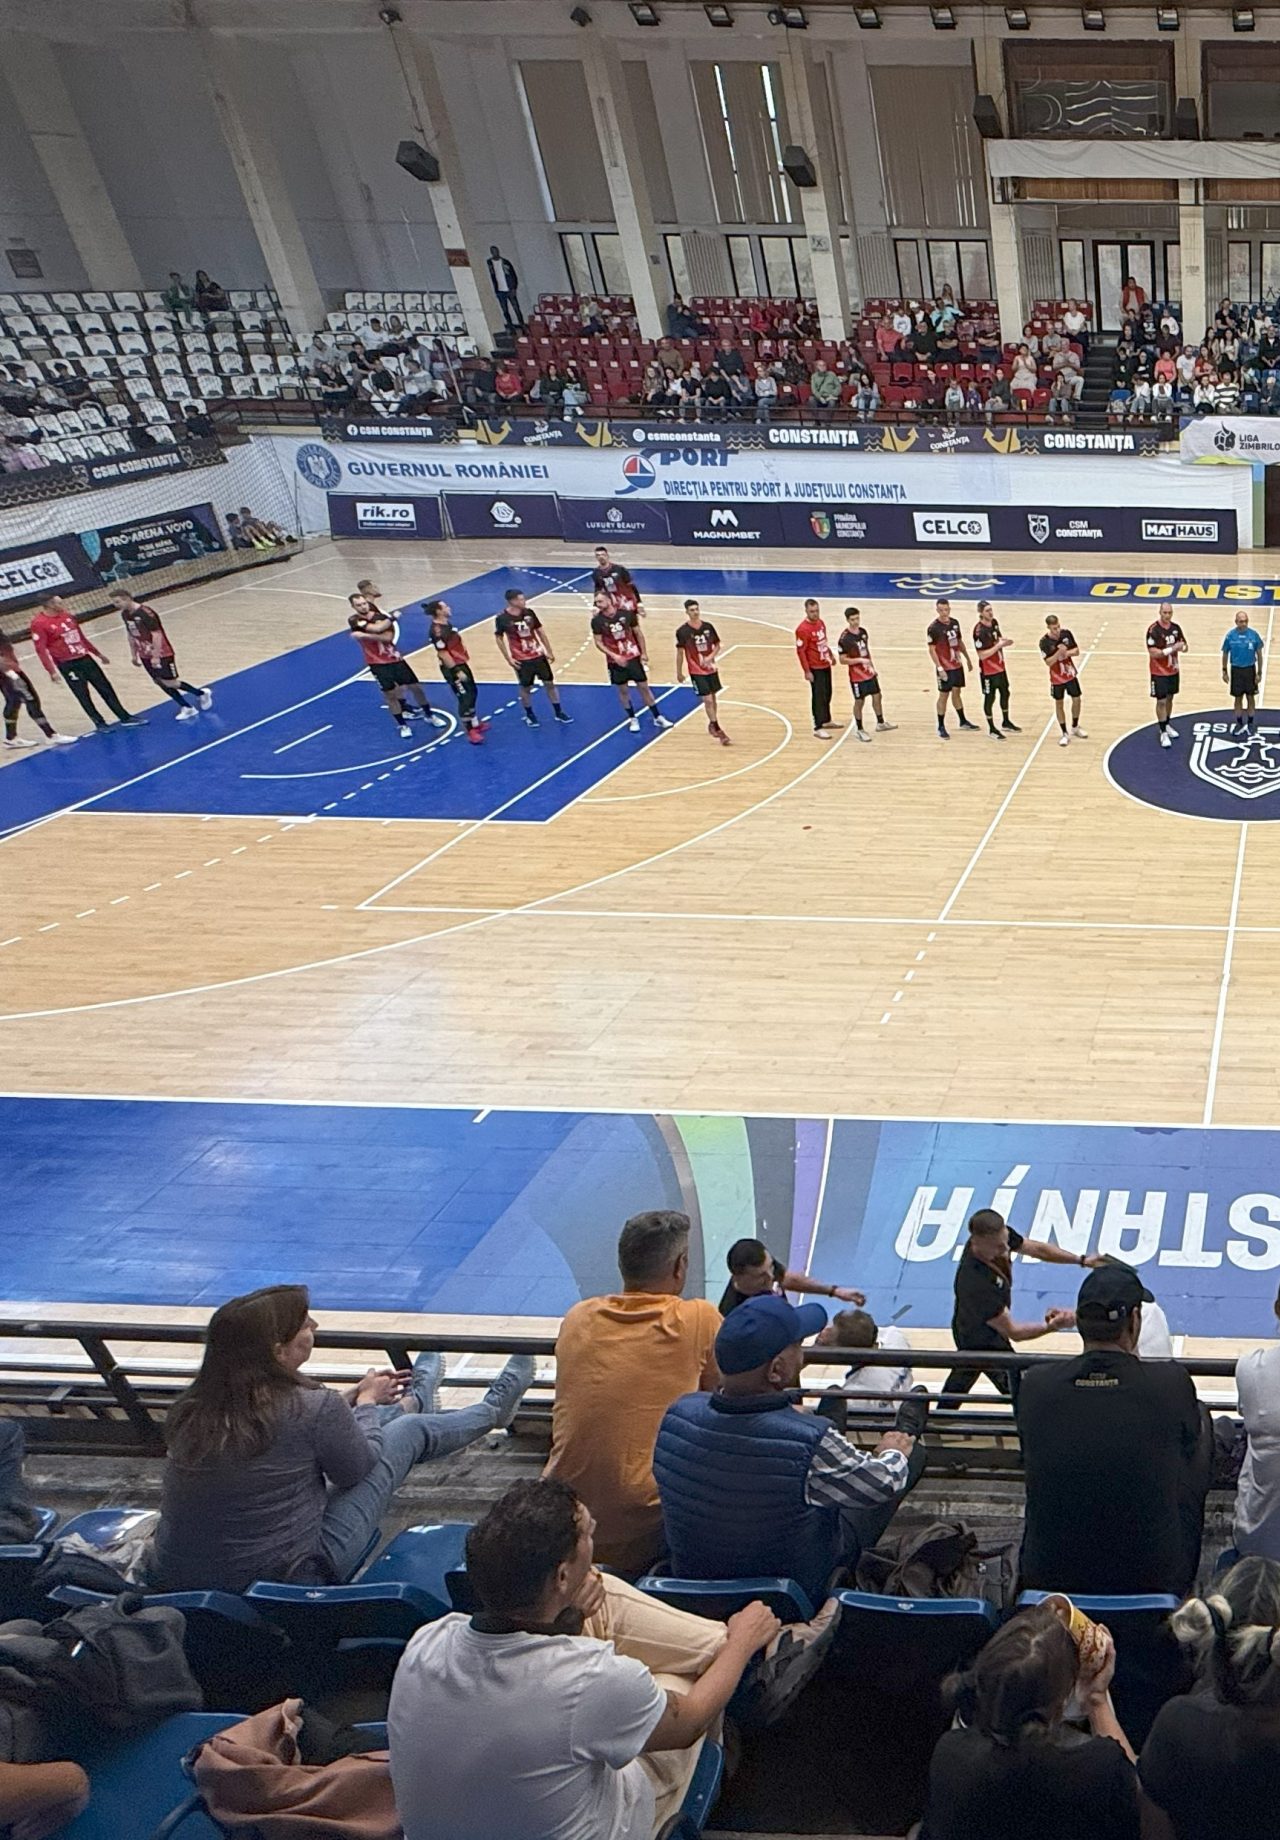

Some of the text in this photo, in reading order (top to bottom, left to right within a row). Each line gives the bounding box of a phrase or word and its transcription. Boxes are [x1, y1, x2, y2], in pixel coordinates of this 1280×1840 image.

[359, 425, 381, 436] CSM
[647, 432, 721, 442] csmconstanta
[769, 428, 859, 447] CONSTANȚA
[1044, 433, 1135, 452] CONSTANȚA
[1239, 434, 1259, 443] LIGA
[348, 460, 550, 479] GUVERNUL ROMÂNIEI
[711, 481, 748, 496] PENTRU
[750, 482, 782, 497] SPORT
[785, 482, 792, 497] A
[363, 506, 410, 518] rik.ro
[586, 522, 646, 530] LUXURY BEAUTY
[1069, 521, 1088, 529] CSM
[694, 531, 761, 540] MAGNUMBET
